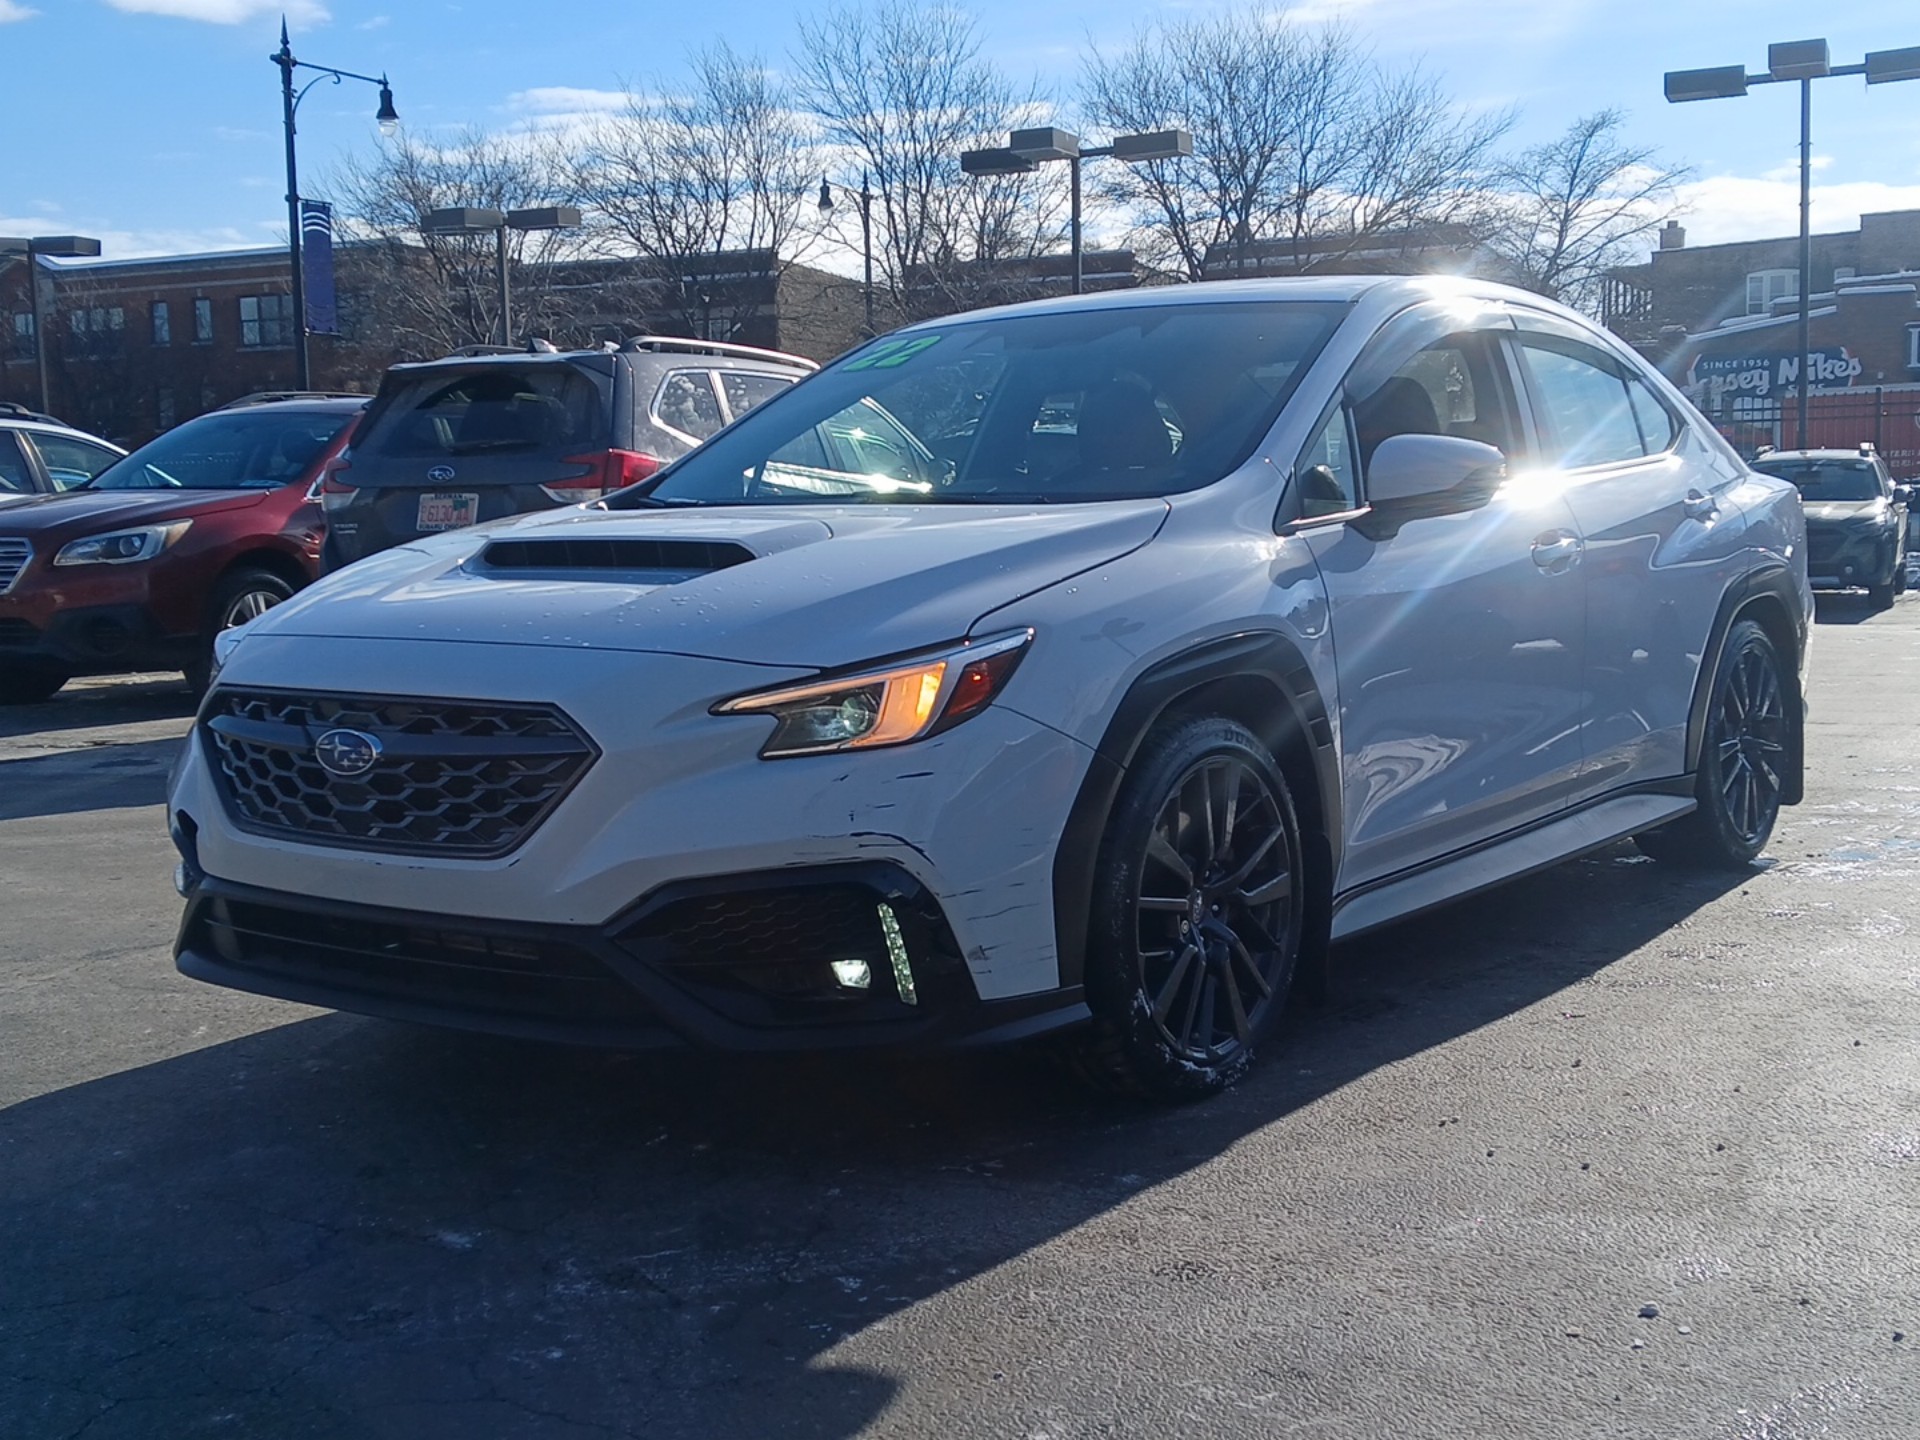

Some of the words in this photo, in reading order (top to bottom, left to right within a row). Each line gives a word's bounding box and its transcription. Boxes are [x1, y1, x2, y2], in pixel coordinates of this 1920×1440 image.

[841, 335, 941, 372] 22
[1703, 359, 1738, 370] SINCE
[1743, 357, 1771, 368] 1956
[1776, 350, 1863, 385] Mike's
